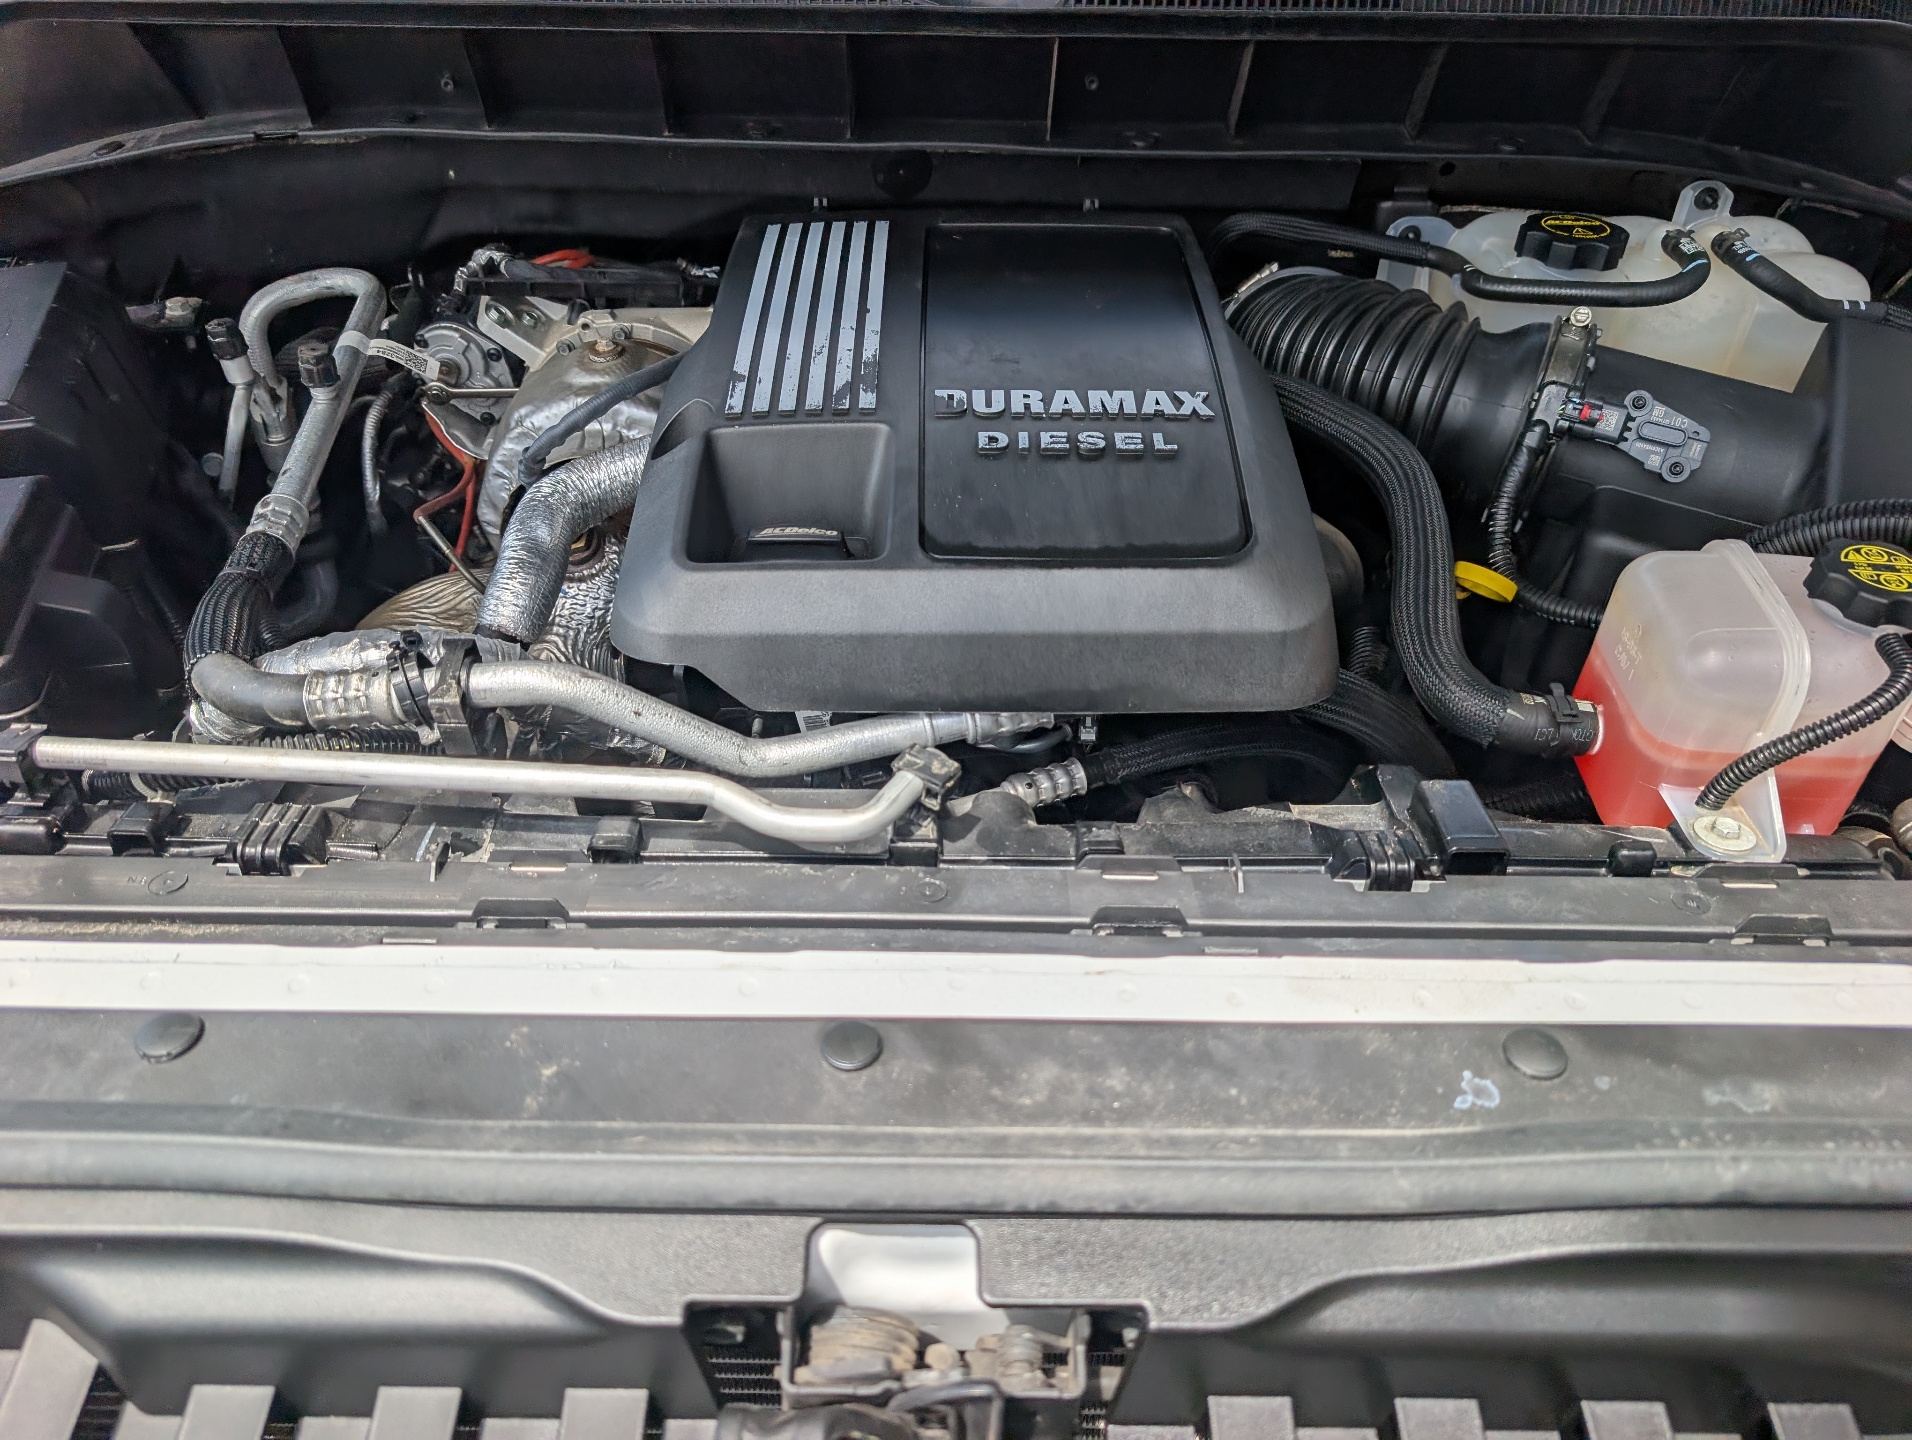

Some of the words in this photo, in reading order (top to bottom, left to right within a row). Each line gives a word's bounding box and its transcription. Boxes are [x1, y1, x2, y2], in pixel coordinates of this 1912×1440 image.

[934, 389, 1216, 420] DURAMAX
[976, 431, 1179, 455] DIESEL
[755, 526, 839, 537] ACDelco
